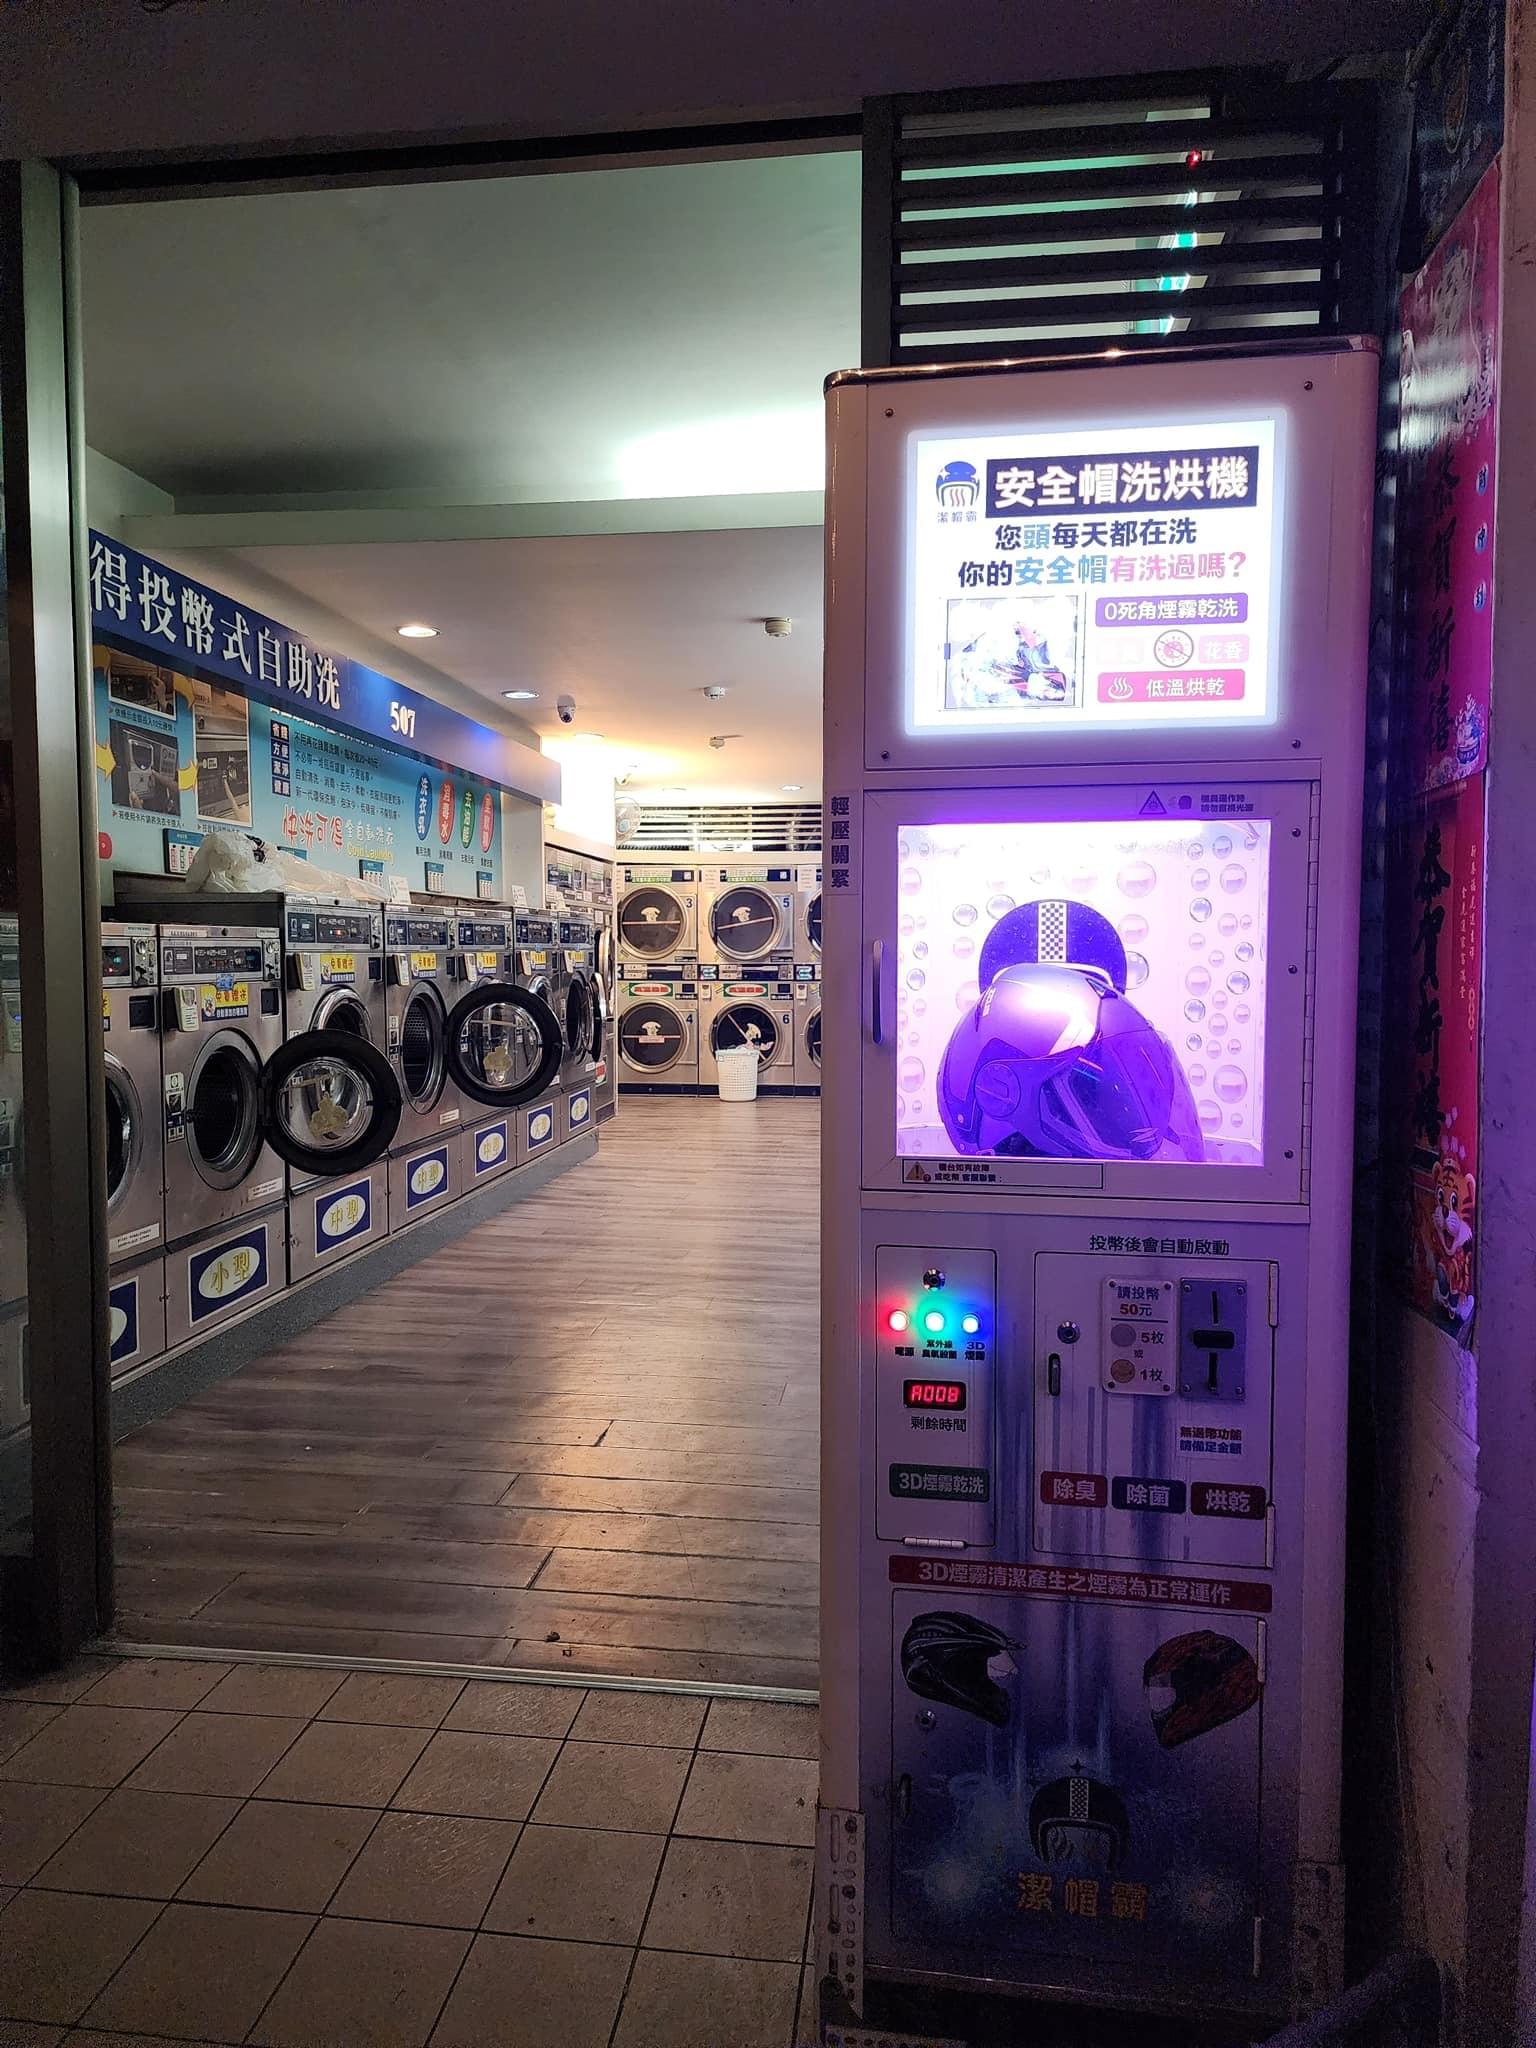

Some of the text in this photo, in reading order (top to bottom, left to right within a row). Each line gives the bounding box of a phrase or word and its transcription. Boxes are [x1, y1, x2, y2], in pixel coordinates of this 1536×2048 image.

[994, 455, 1249, 508] 安全帽洗烘機
[995, 517, 1197, 550] 您頭每天都在洗
[958, 551, 1247, 588] 你的安全帽有洗過嗎?
[1104, 597, 1239, 620] 0死角煙霧乾洗
[88, 539, 341, 710] 得投幣式自助洗
[1146, 677, 1225, 698] 低溫烘乾
[390, 701, 416, 738] 507
[830, 796, 850, 889] 輕壓關緊
[686, 898, 693, 908] 3
[783, 898, 790, 908] 5
[686, 1013, 693, 1024] 4
[783, 1014, 790, 1024] 6
[418, 1162, 440, 1193] 中型
[329, 1198, 359, 1233] 中型
[1089, 1235, 1230, 1256] 投幣後會自動啟動
[211, 1249, 250, 1294] 小型
[1117, 1286, 1160, 1301] 請投幣
[1119, 1303, 1153, 1317] 50元
[966, 1342, 986, 1350] 3D
[1141, 1331, 1165, 1345] 5枚
[1140, 1368, 1163, 1382] 1枚
[910, 1416, 967, 1432] 剩餘時間
[898, 1472, 985, 1495] 3D煙霧乾洗
[1053, 1478, 1097, 1501] 除臭
[1126, 1484, 1171, 1507] 除菌
[1205, 1490, 1251, 1514] 烘乾
